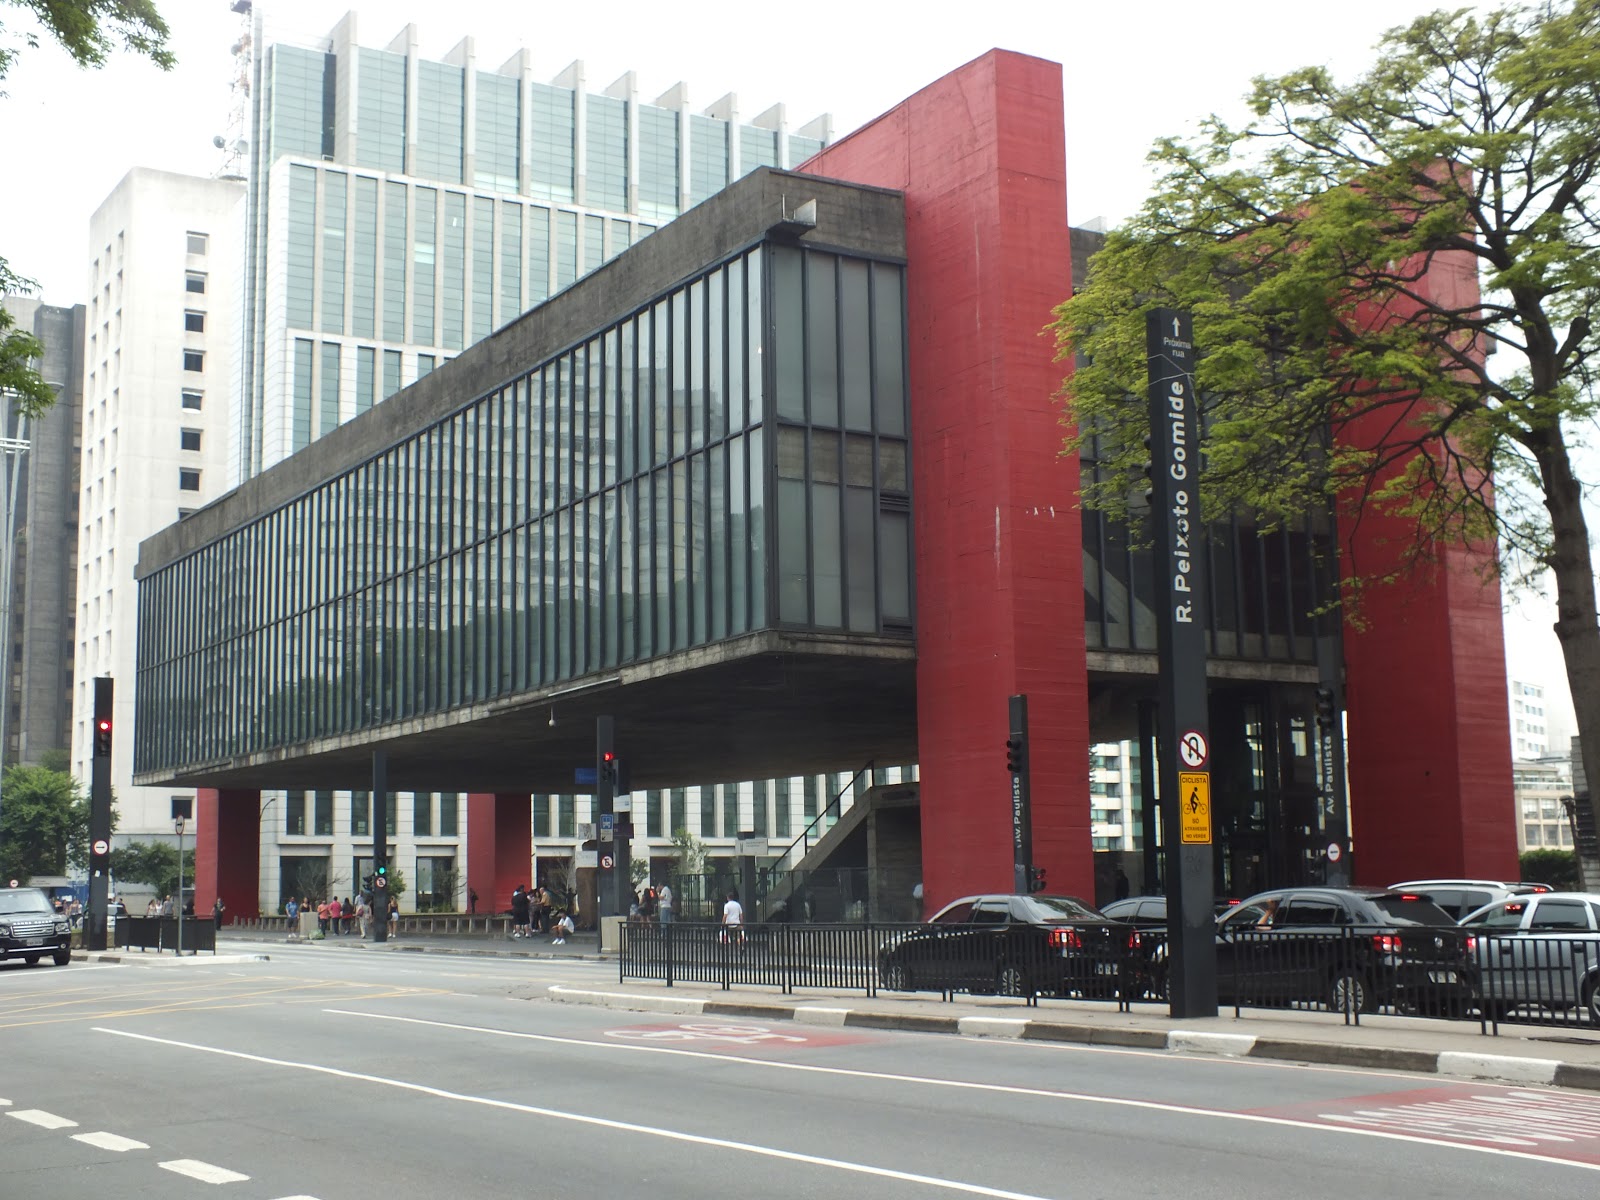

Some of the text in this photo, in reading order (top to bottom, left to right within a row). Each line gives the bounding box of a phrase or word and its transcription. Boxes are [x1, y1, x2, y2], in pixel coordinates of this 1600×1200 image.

[1172, 350, 1185, 358] rua
[1168, 381, 1192, 623] R. Peixoto Gomide
[1013, 777, 1021, 825] Paulista
[1324, 736, 1335, 815] Av. Paulista
